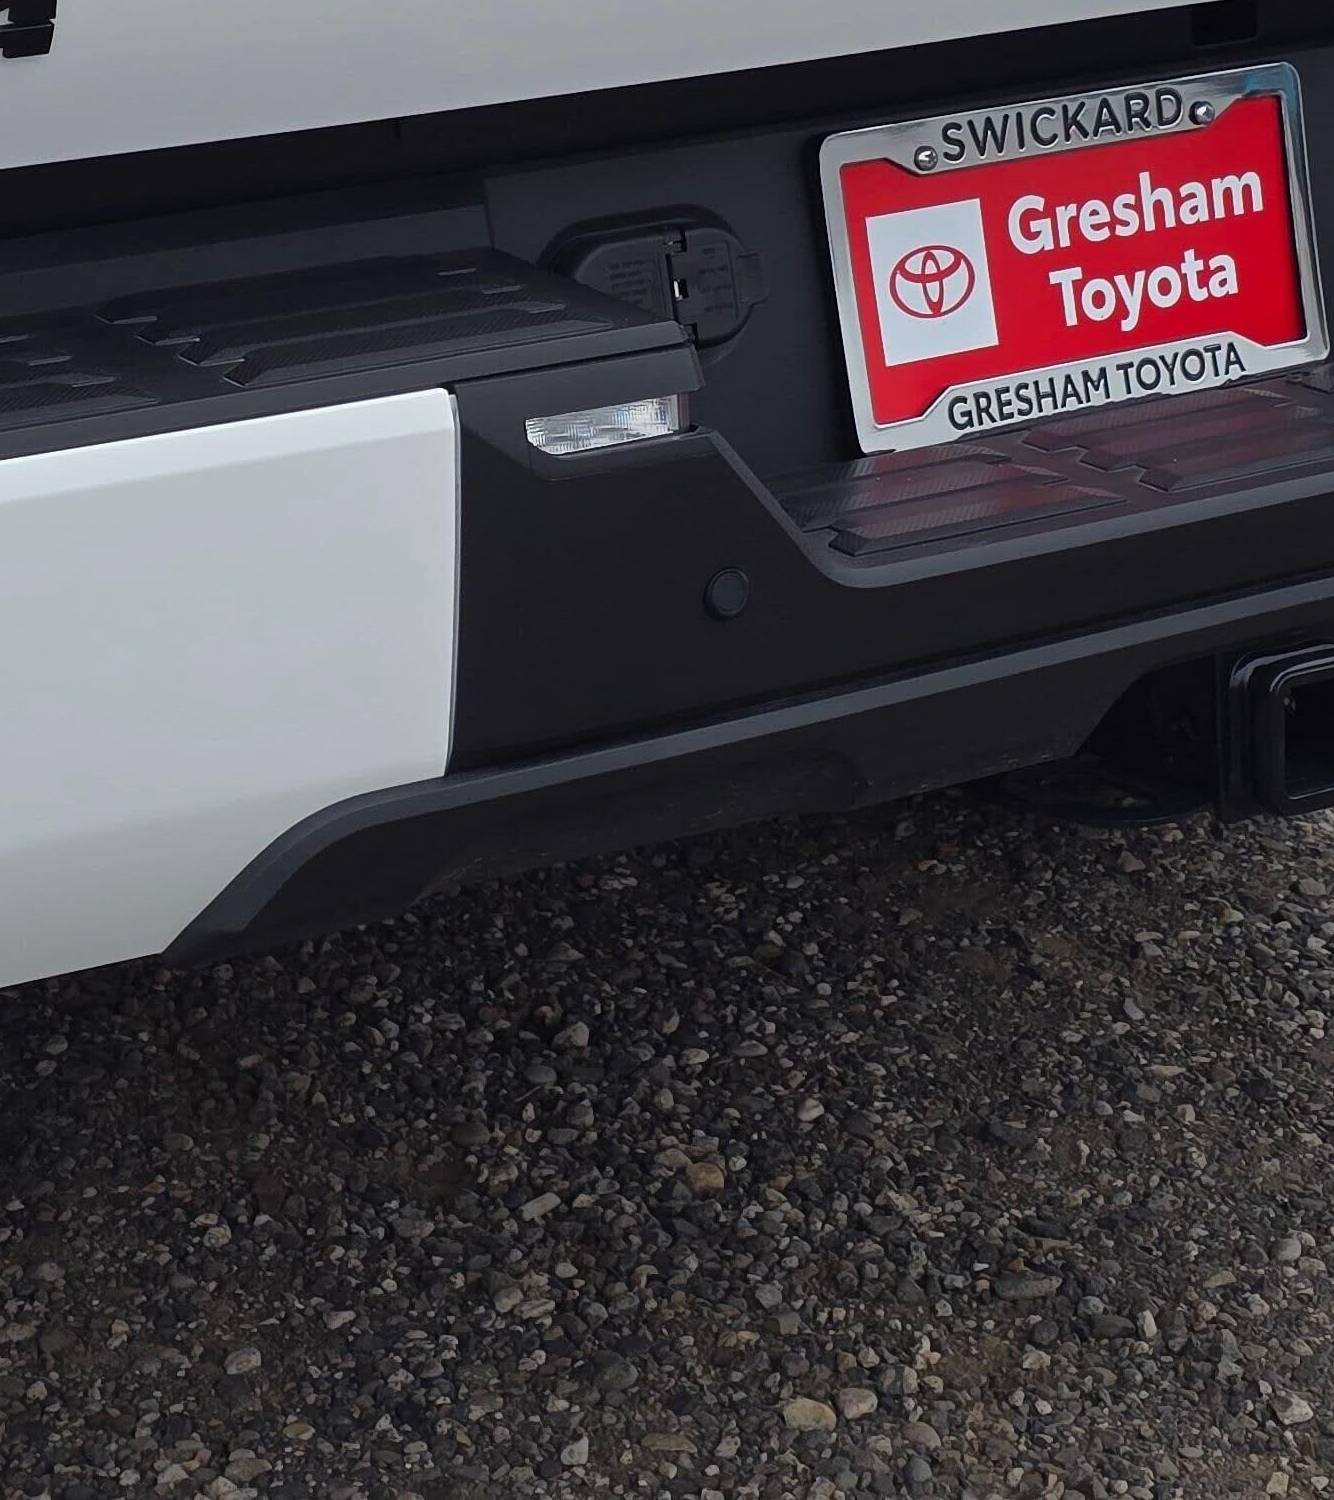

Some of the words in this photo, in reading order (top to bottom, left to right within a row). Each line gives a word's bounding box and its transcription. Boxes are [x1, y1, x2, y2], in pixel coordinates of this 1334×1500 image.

[940, 88, 1184, 164] SWICKARD
[1007, 171, 1264, 256] Gresham
[1049, 249, 1239, 332] Toyota
[947, 366, 1110, 433] GRESHAM
[1115, 341, 1246, 396] TOYOTA
